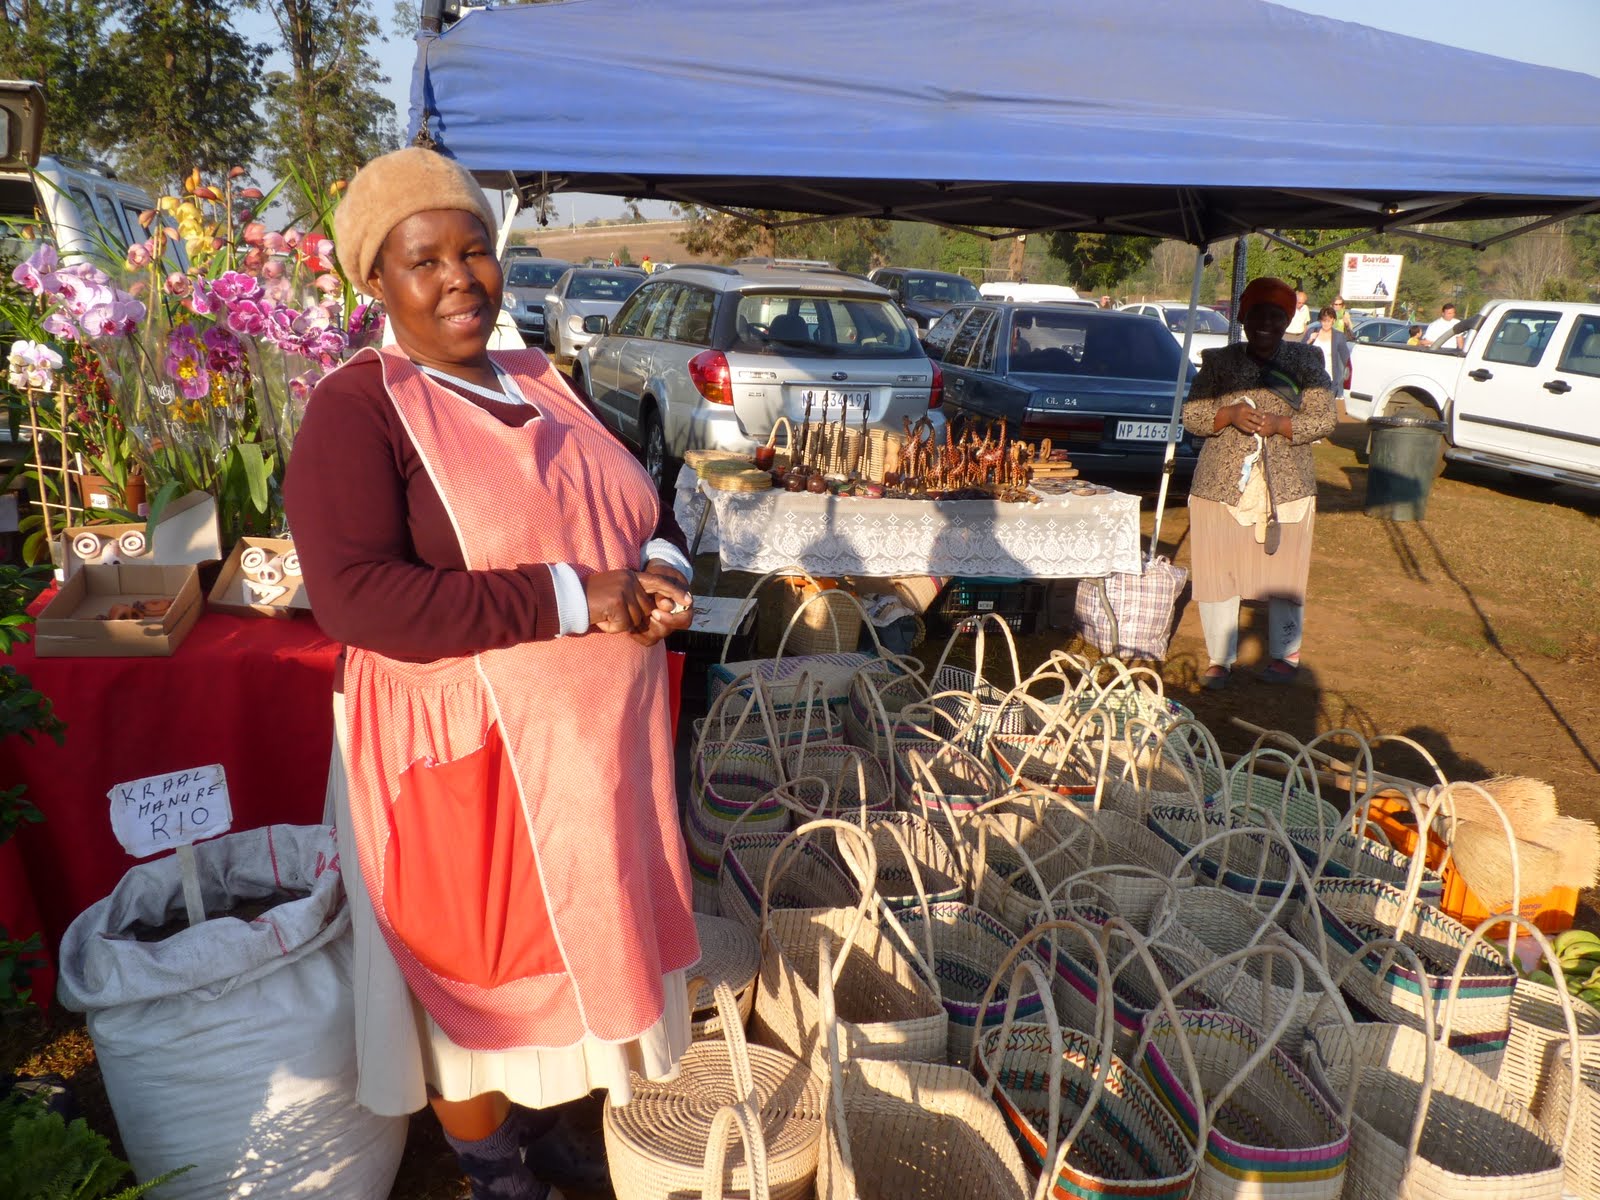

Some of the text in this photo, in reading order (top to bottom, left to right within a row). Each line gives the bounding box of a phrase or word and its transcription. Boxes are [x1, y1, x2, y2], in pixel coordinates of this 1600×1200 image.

[1362, 254, 1390, 264] Boavida
[1046, 396, 1059, 405] GL
[1118, 423, 1183, 440] NP 116-33
[121, 771, 207, 806] KRAAL
[150, 807, 209, 840] R10
